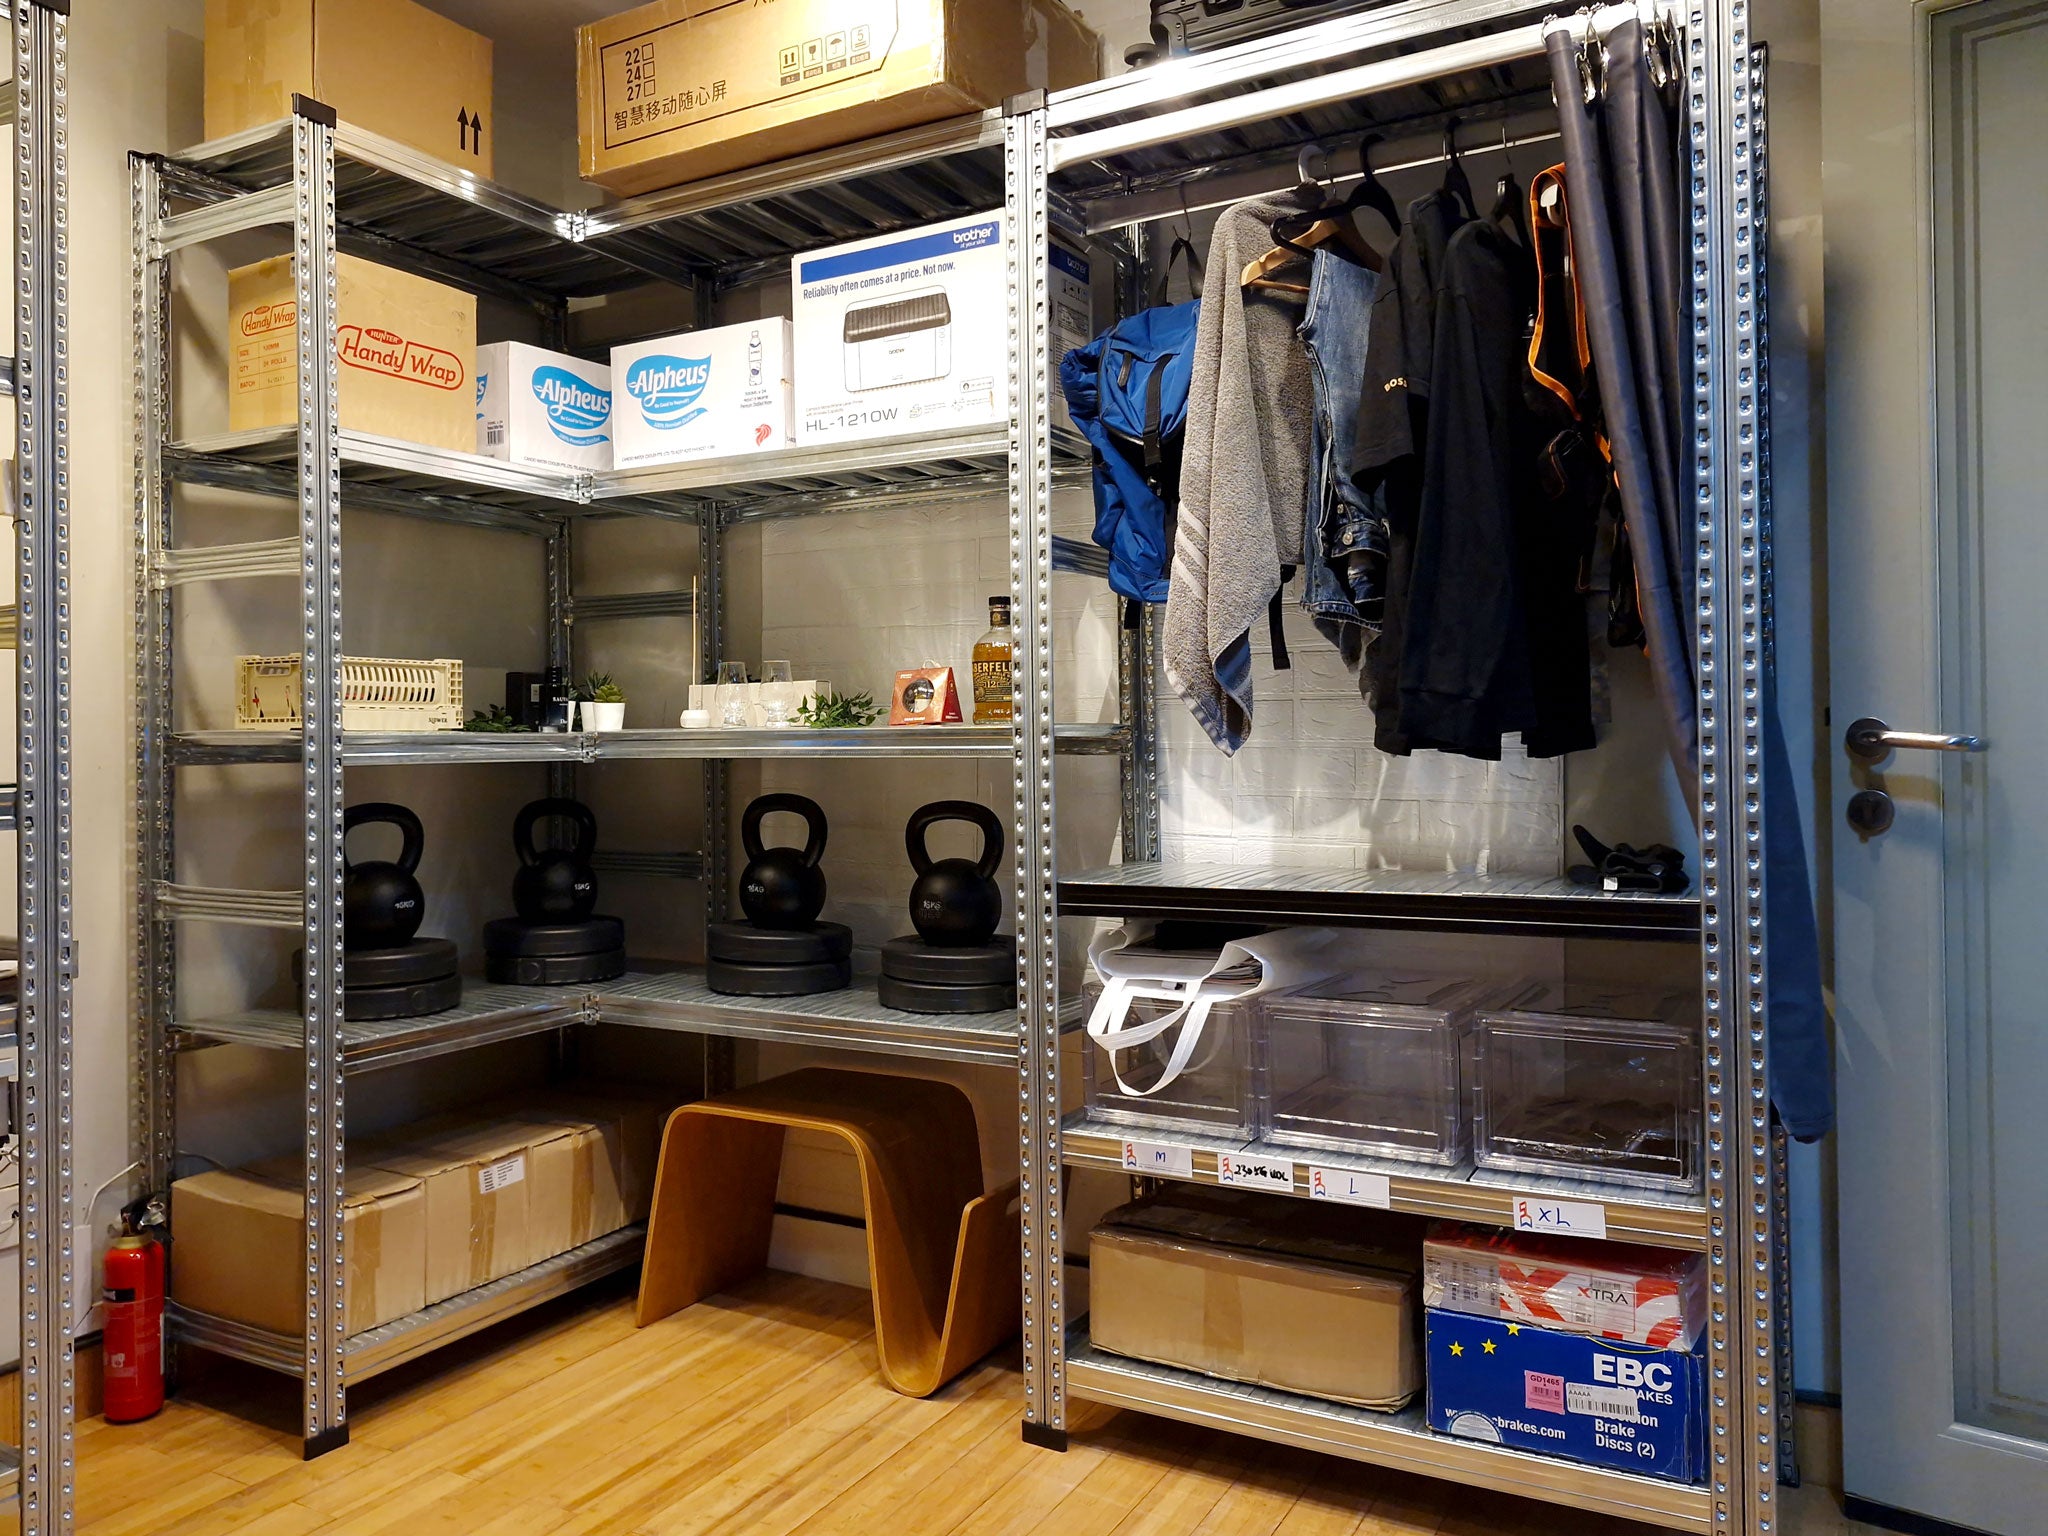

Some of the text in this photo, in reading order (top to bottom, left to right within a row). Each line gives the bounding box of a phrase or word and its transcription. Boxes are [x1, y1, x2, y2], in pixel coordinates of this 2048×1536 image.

[625, 48, 640, 66] 22
[626, 66, 641, 84] 24
[627, 84, 642, 101] 27
[614, 80, 727, 131] 智慧移动随心屏
[953, 227, 993, 244] brother
[803, 262, 956, 300] Reliability often comes at a price. Not now.
[245, 313, 271, 332] Handy
[273, 307, 296, 323] Wrap
[370, 330, 399, 344] HUNTER
[343, 337, 457, 384] Handy Wrap
[630, 364, 708, 407] Alpheus
[536, 378, 610, 416] Alpheus
[806, 407, 898, 433] HL-1210W
[1349, 1177, 1359, 1194] L
[1577, 1286, 1629, 1305] XTRA
[1530, 1374, 1560, 1387] GD1465
[1593, 1353, 1673, 1393] EBC
[1618, 1387, 1673, 1405] AKES
[1595, 1418, 1636, 1438] Brake
[1595, 1433, 1656, 1460] Discs (2)
